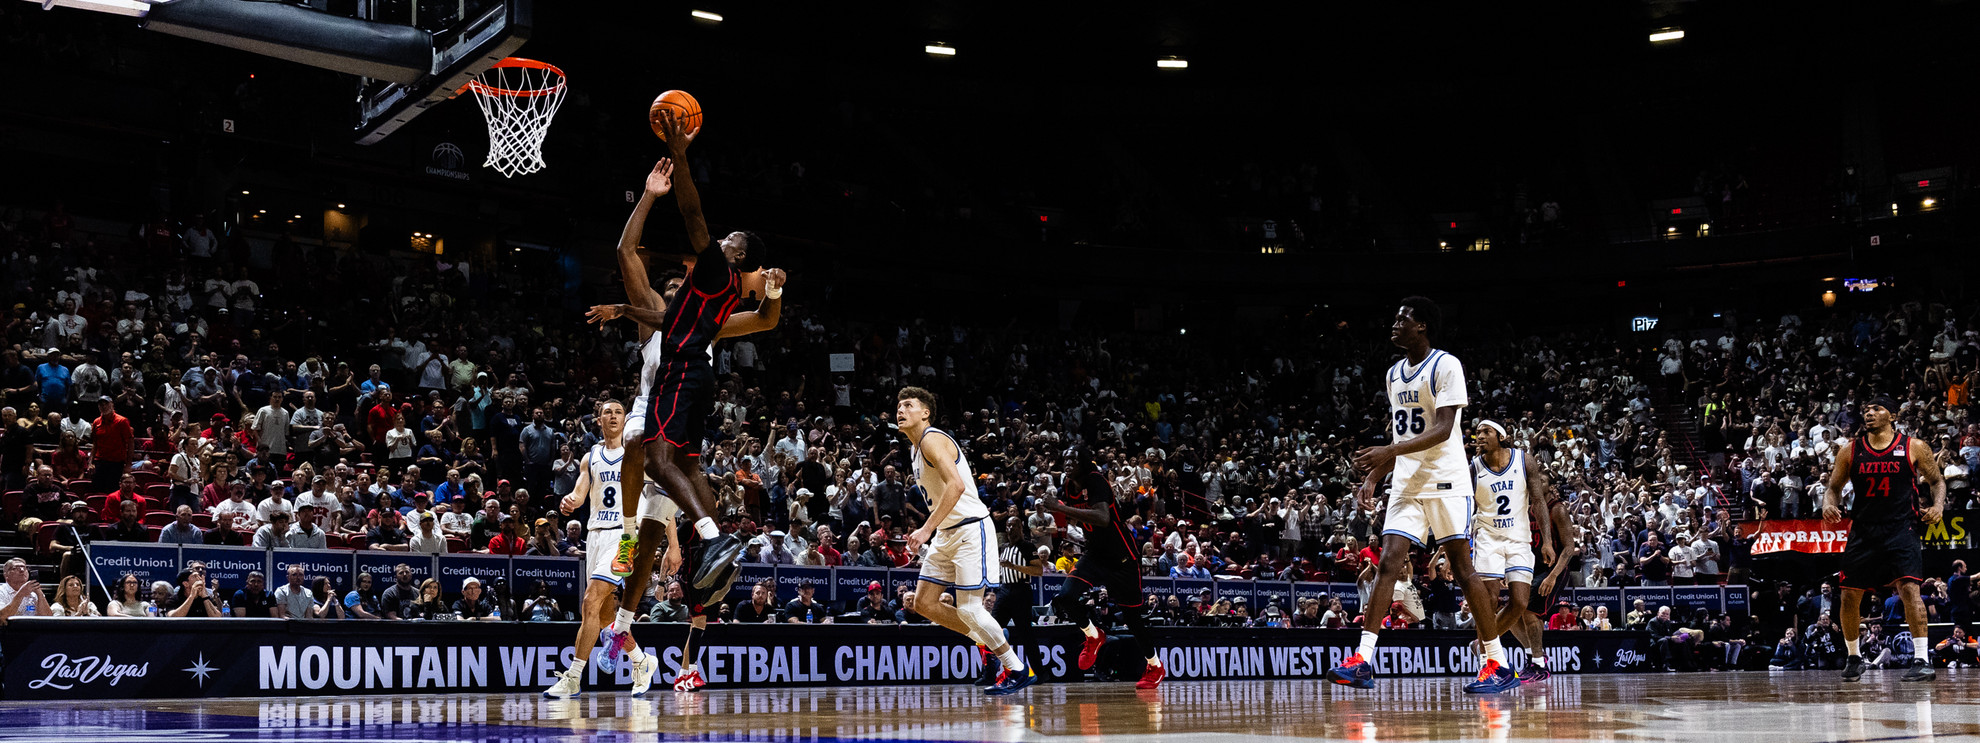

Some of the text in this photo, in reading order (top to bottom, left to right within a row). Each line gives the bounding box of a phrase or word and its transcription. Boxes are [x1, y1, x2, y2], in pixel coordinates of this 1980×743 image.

[225, 121, 232, 131] 2
[627, 191, 633, 201] 3
[1398, 390, 1419, 404] UTAH
[1395, 408, 1425, 435] 35
[1859, 461, 1900, 474] AZTECS
[1490, 480, 1514, 493] UTAH
[1866, 476, 1891, 497] 24
[603, 486, 616, 508] 8
[1496, 495, 1511, 515] 2
[597, 510, 620, 521] STATE
[1493, 517, 1515, 528] STATE
[1920, 516, 1966, 541] MS
[1747, 530, 1848, 544] ATORADE
[95, 556, 131, 567] Credit
[187, 559, 220, 570] Cdit
[277, 562, 310, 572] Crit
[361, 564, 391, 574] Credit
[442, 567, 471, 576] Credit
[515, 568, 544, 577] Credit
[747, 575, 768, 583] Union
[779, 576, 800, 584] Credit
[838, 577, 858, 585] Credit
[1825, 645, 1835, 653] 36
[1268, 646, 1324, 676] WEST
[1449, 646, 1581, 674] CHIOHIPS
[259, 645, 458, 690] MOUNTAIN
[834, 645, 1067, 681] CHAMPIOPS
